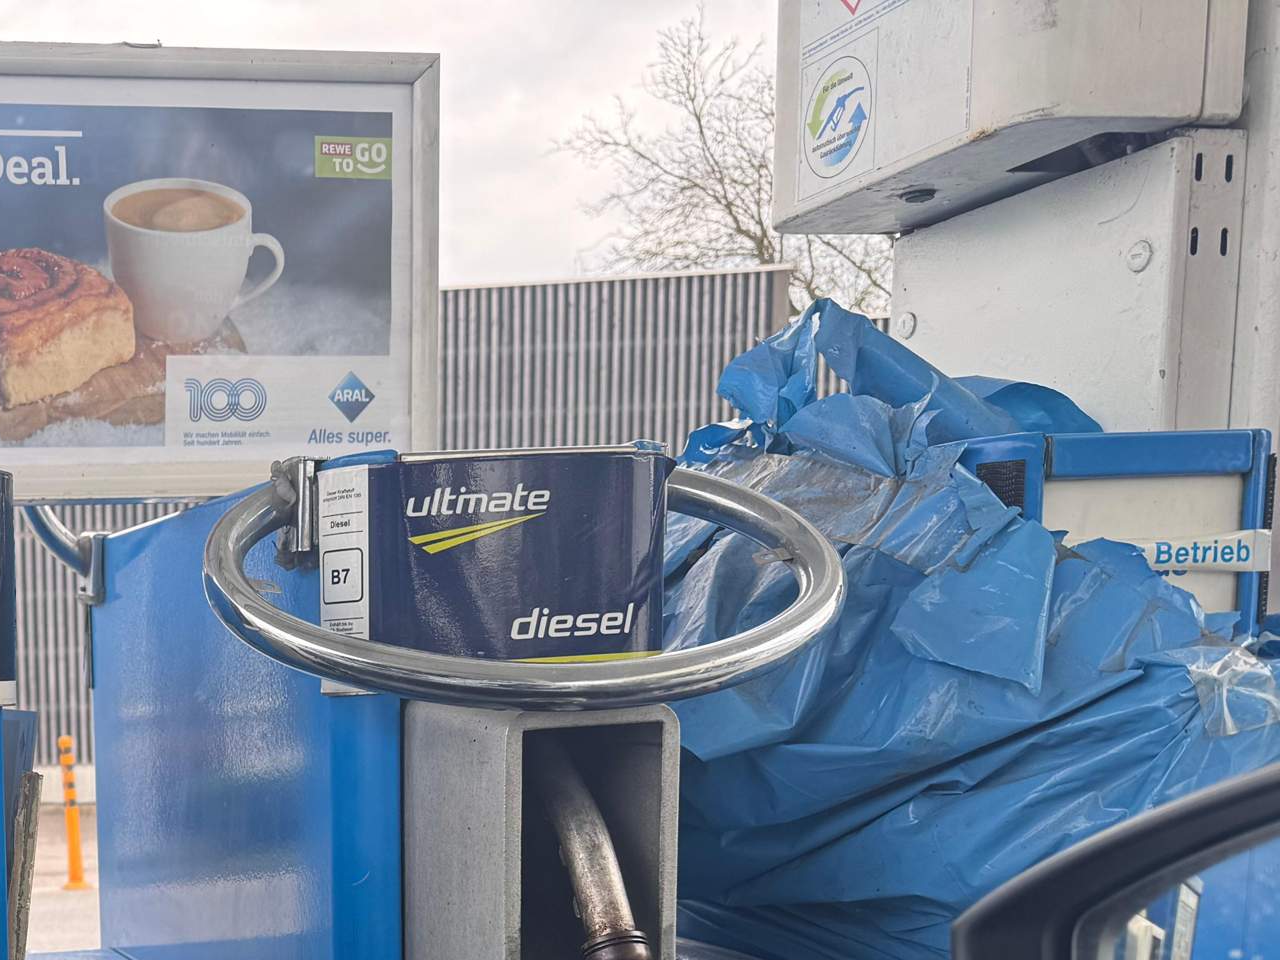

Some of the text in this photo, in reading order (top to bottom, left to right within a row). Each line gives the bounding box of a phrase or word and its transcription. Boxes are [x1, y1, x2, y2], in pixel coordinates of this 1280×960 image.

[322, 143, 352, 155] REWE
[332, 143, 387, 173] TO GO
[184, 378, 267, 423] 100
[334, 389, 370, 402] ARAL
[308, 428, 391, 446] Alles super.
[406, 483, 551, 518] ultimate
[331, 519, 351, 529] Diesel
[1154, 539, 1250, 565] Betrieb
[331, 568, 351, 585] B7
[510, 602, 635, 640] diesel
